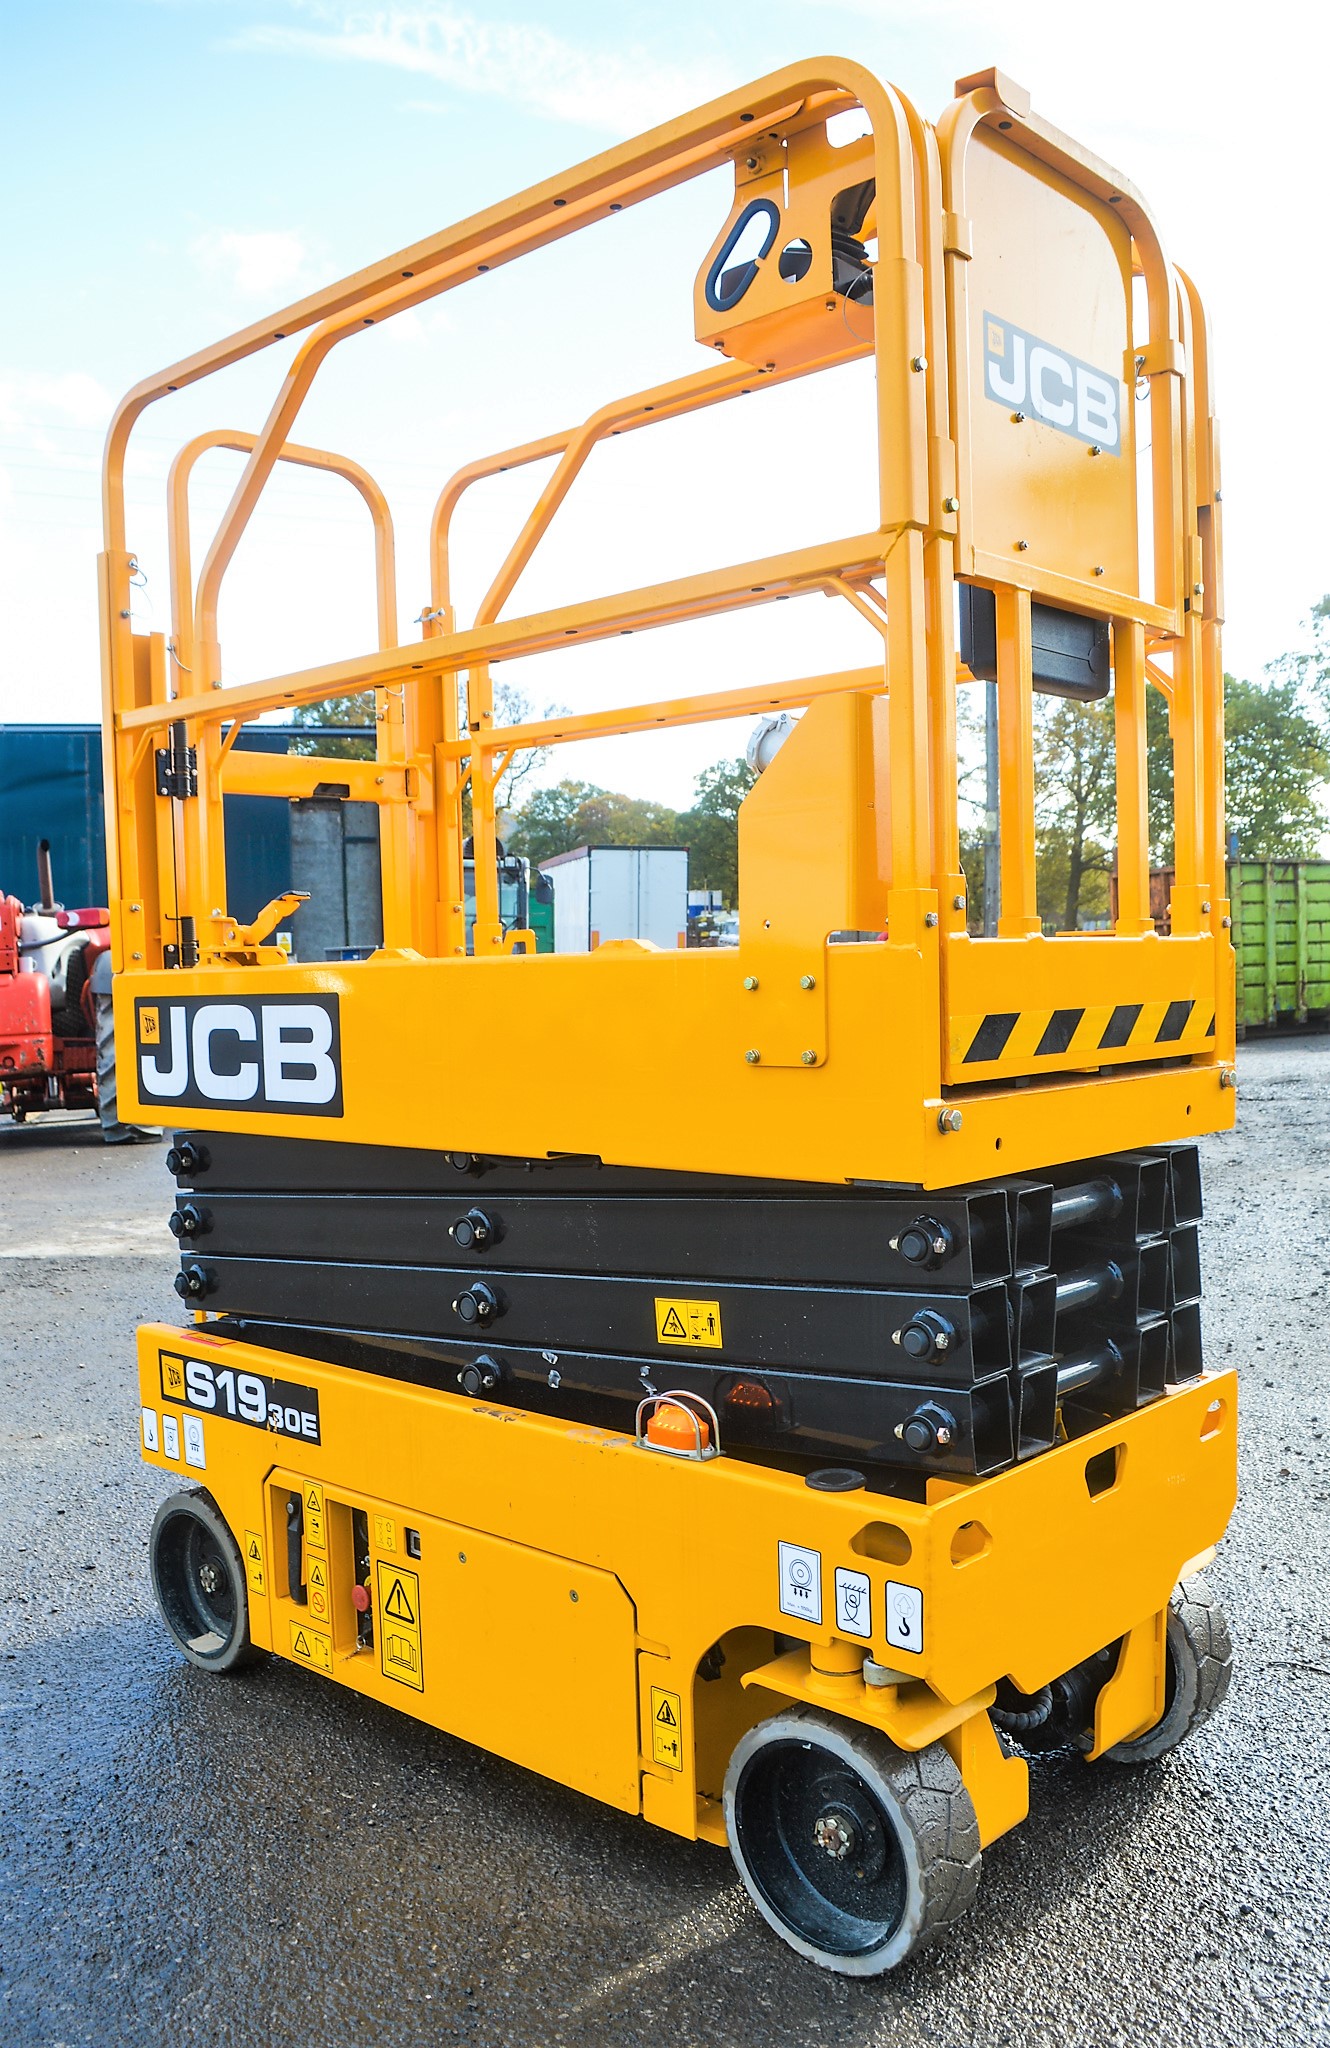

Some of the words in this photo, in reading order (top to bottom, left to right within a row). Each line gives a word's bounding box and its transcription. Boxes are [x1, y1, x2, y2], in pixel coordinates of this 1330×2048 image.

[988, 334, 1118, 446] JCB
[140, 1004, 337, 1104] JCB
[168, 1367, 181, 1386] JCB
